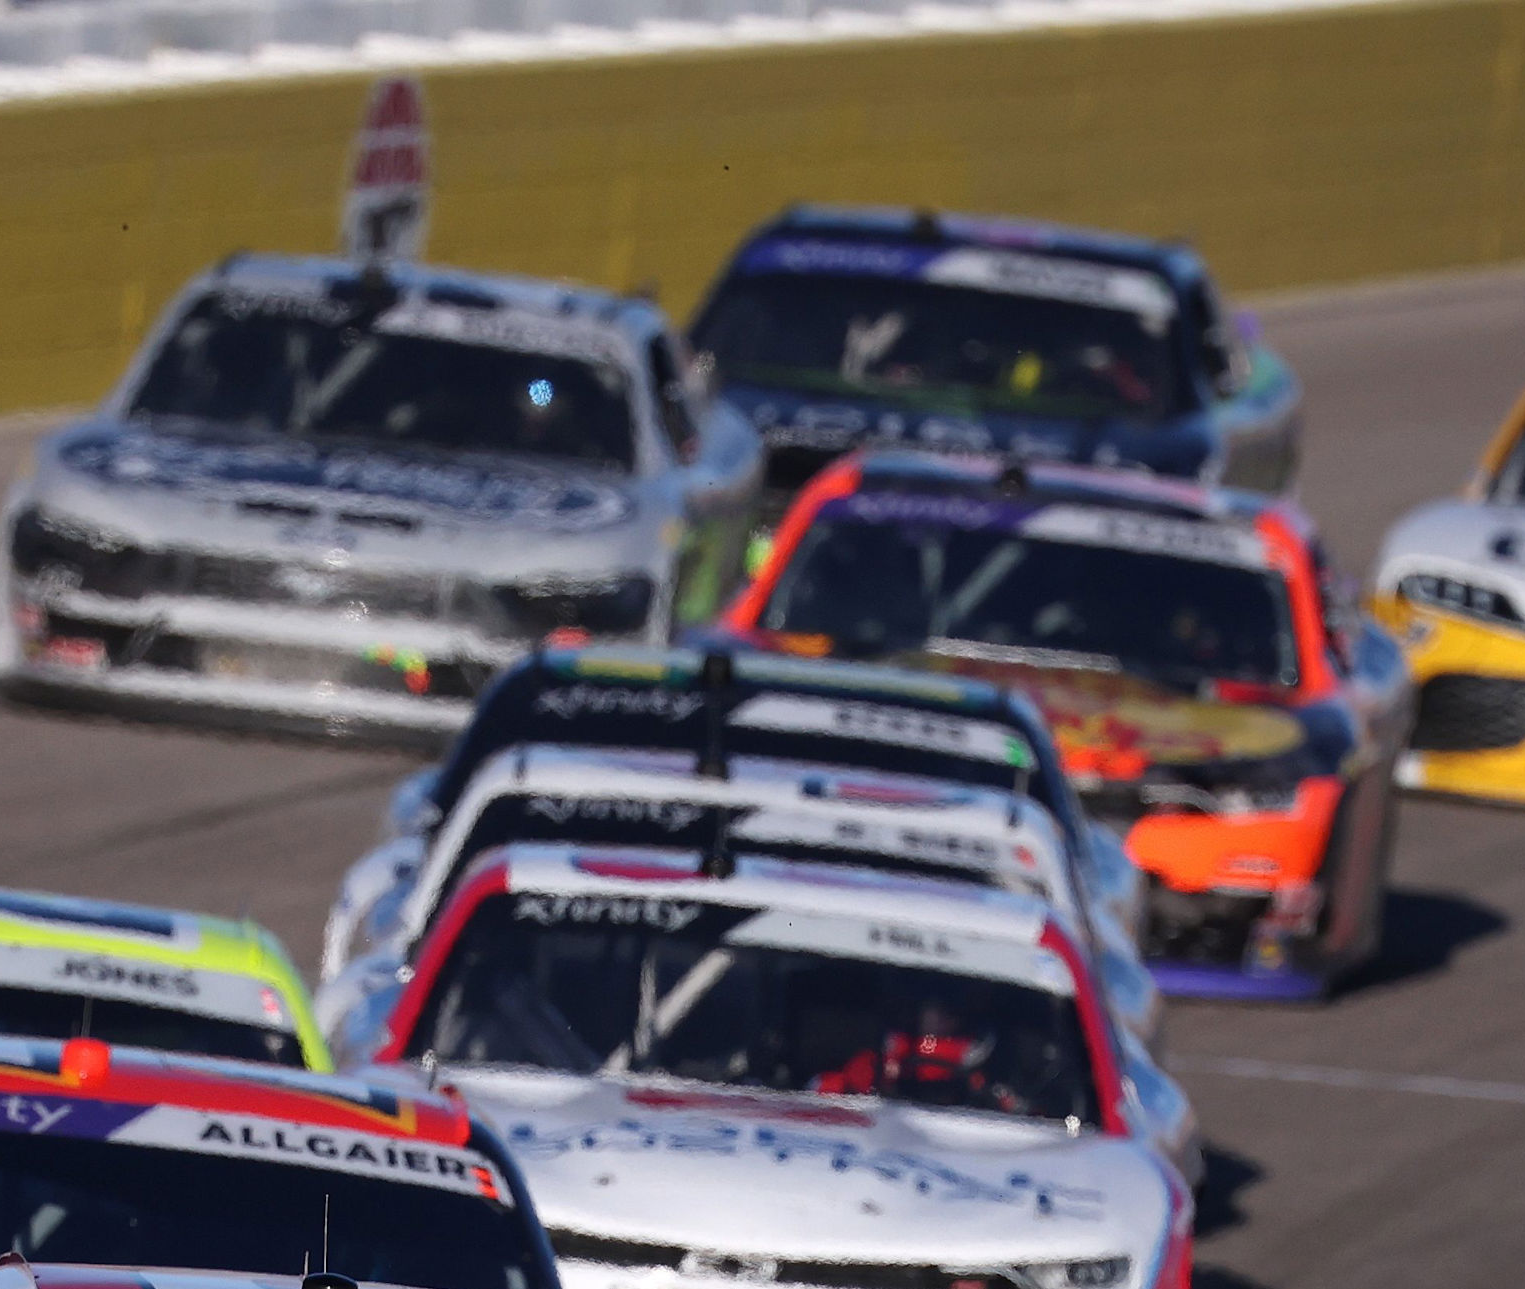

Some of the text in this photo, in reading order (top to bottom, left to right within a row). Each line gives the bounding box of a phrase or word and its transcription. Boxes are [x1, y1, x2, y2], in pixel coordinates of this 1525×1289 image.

[512, 898, 704, 932] xfinity
[54, 957, 200, 997] JONES
[200, 1120, 469, 1182] ALLGAIER
